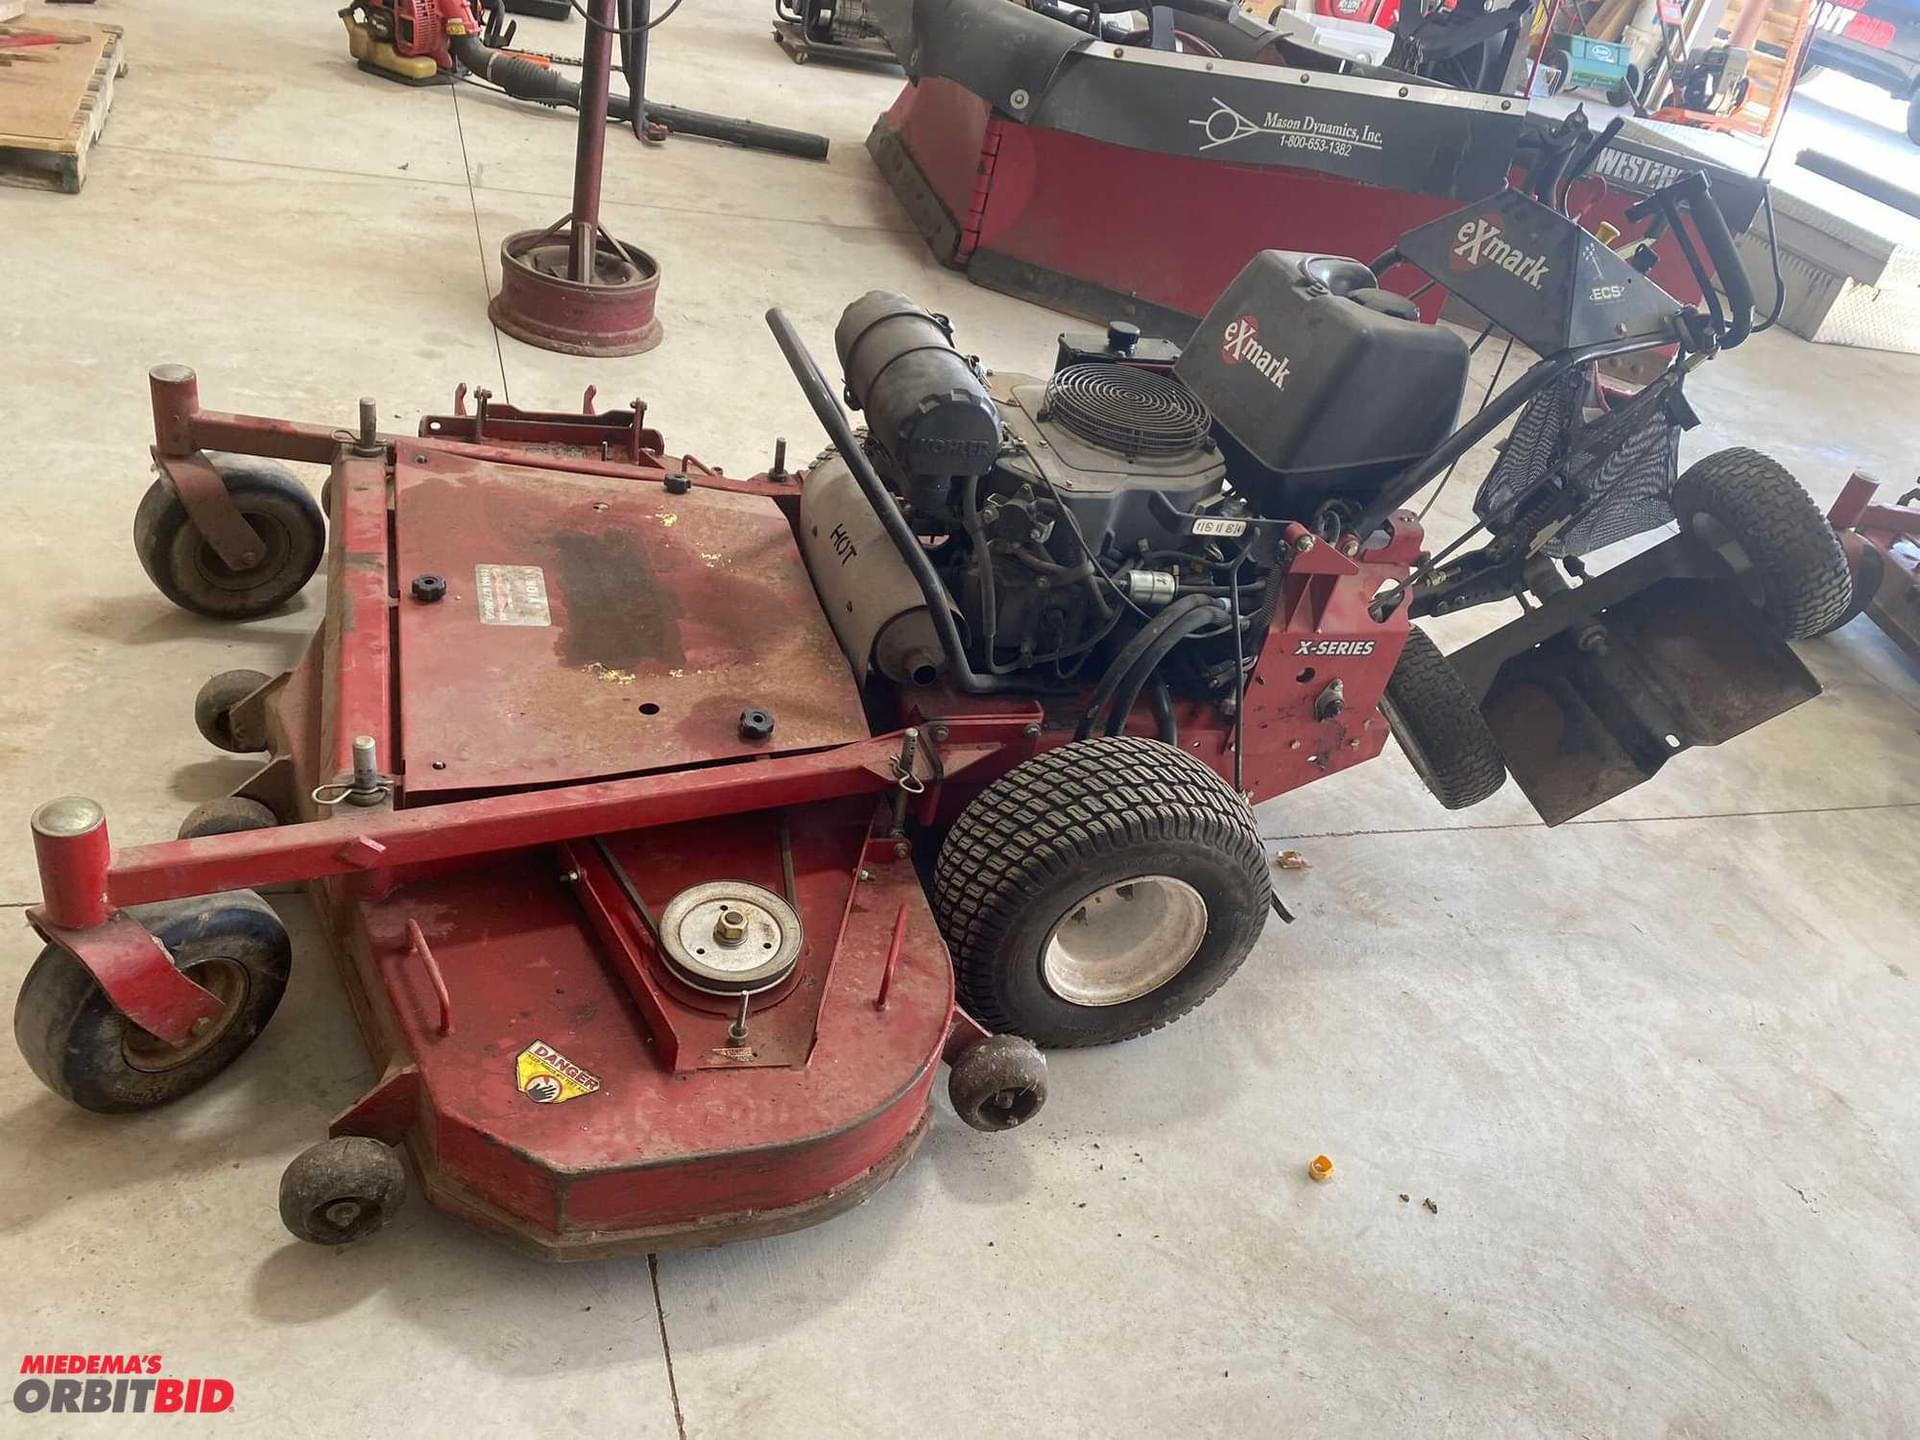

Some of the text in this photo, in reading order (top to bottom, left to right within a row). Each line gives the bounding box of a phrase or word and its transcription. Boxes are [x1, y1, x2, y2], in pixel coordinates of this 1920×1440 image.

[1264, 112, 1383, 144] Mason Dynamics, Inc.
[1591, 285, 1622, 300] ECS
[830, 523, 857, 566] HOT
[1295, 640, 1375, 656] X-SERIES
[534, 1046, 599, 1090] DANGER
